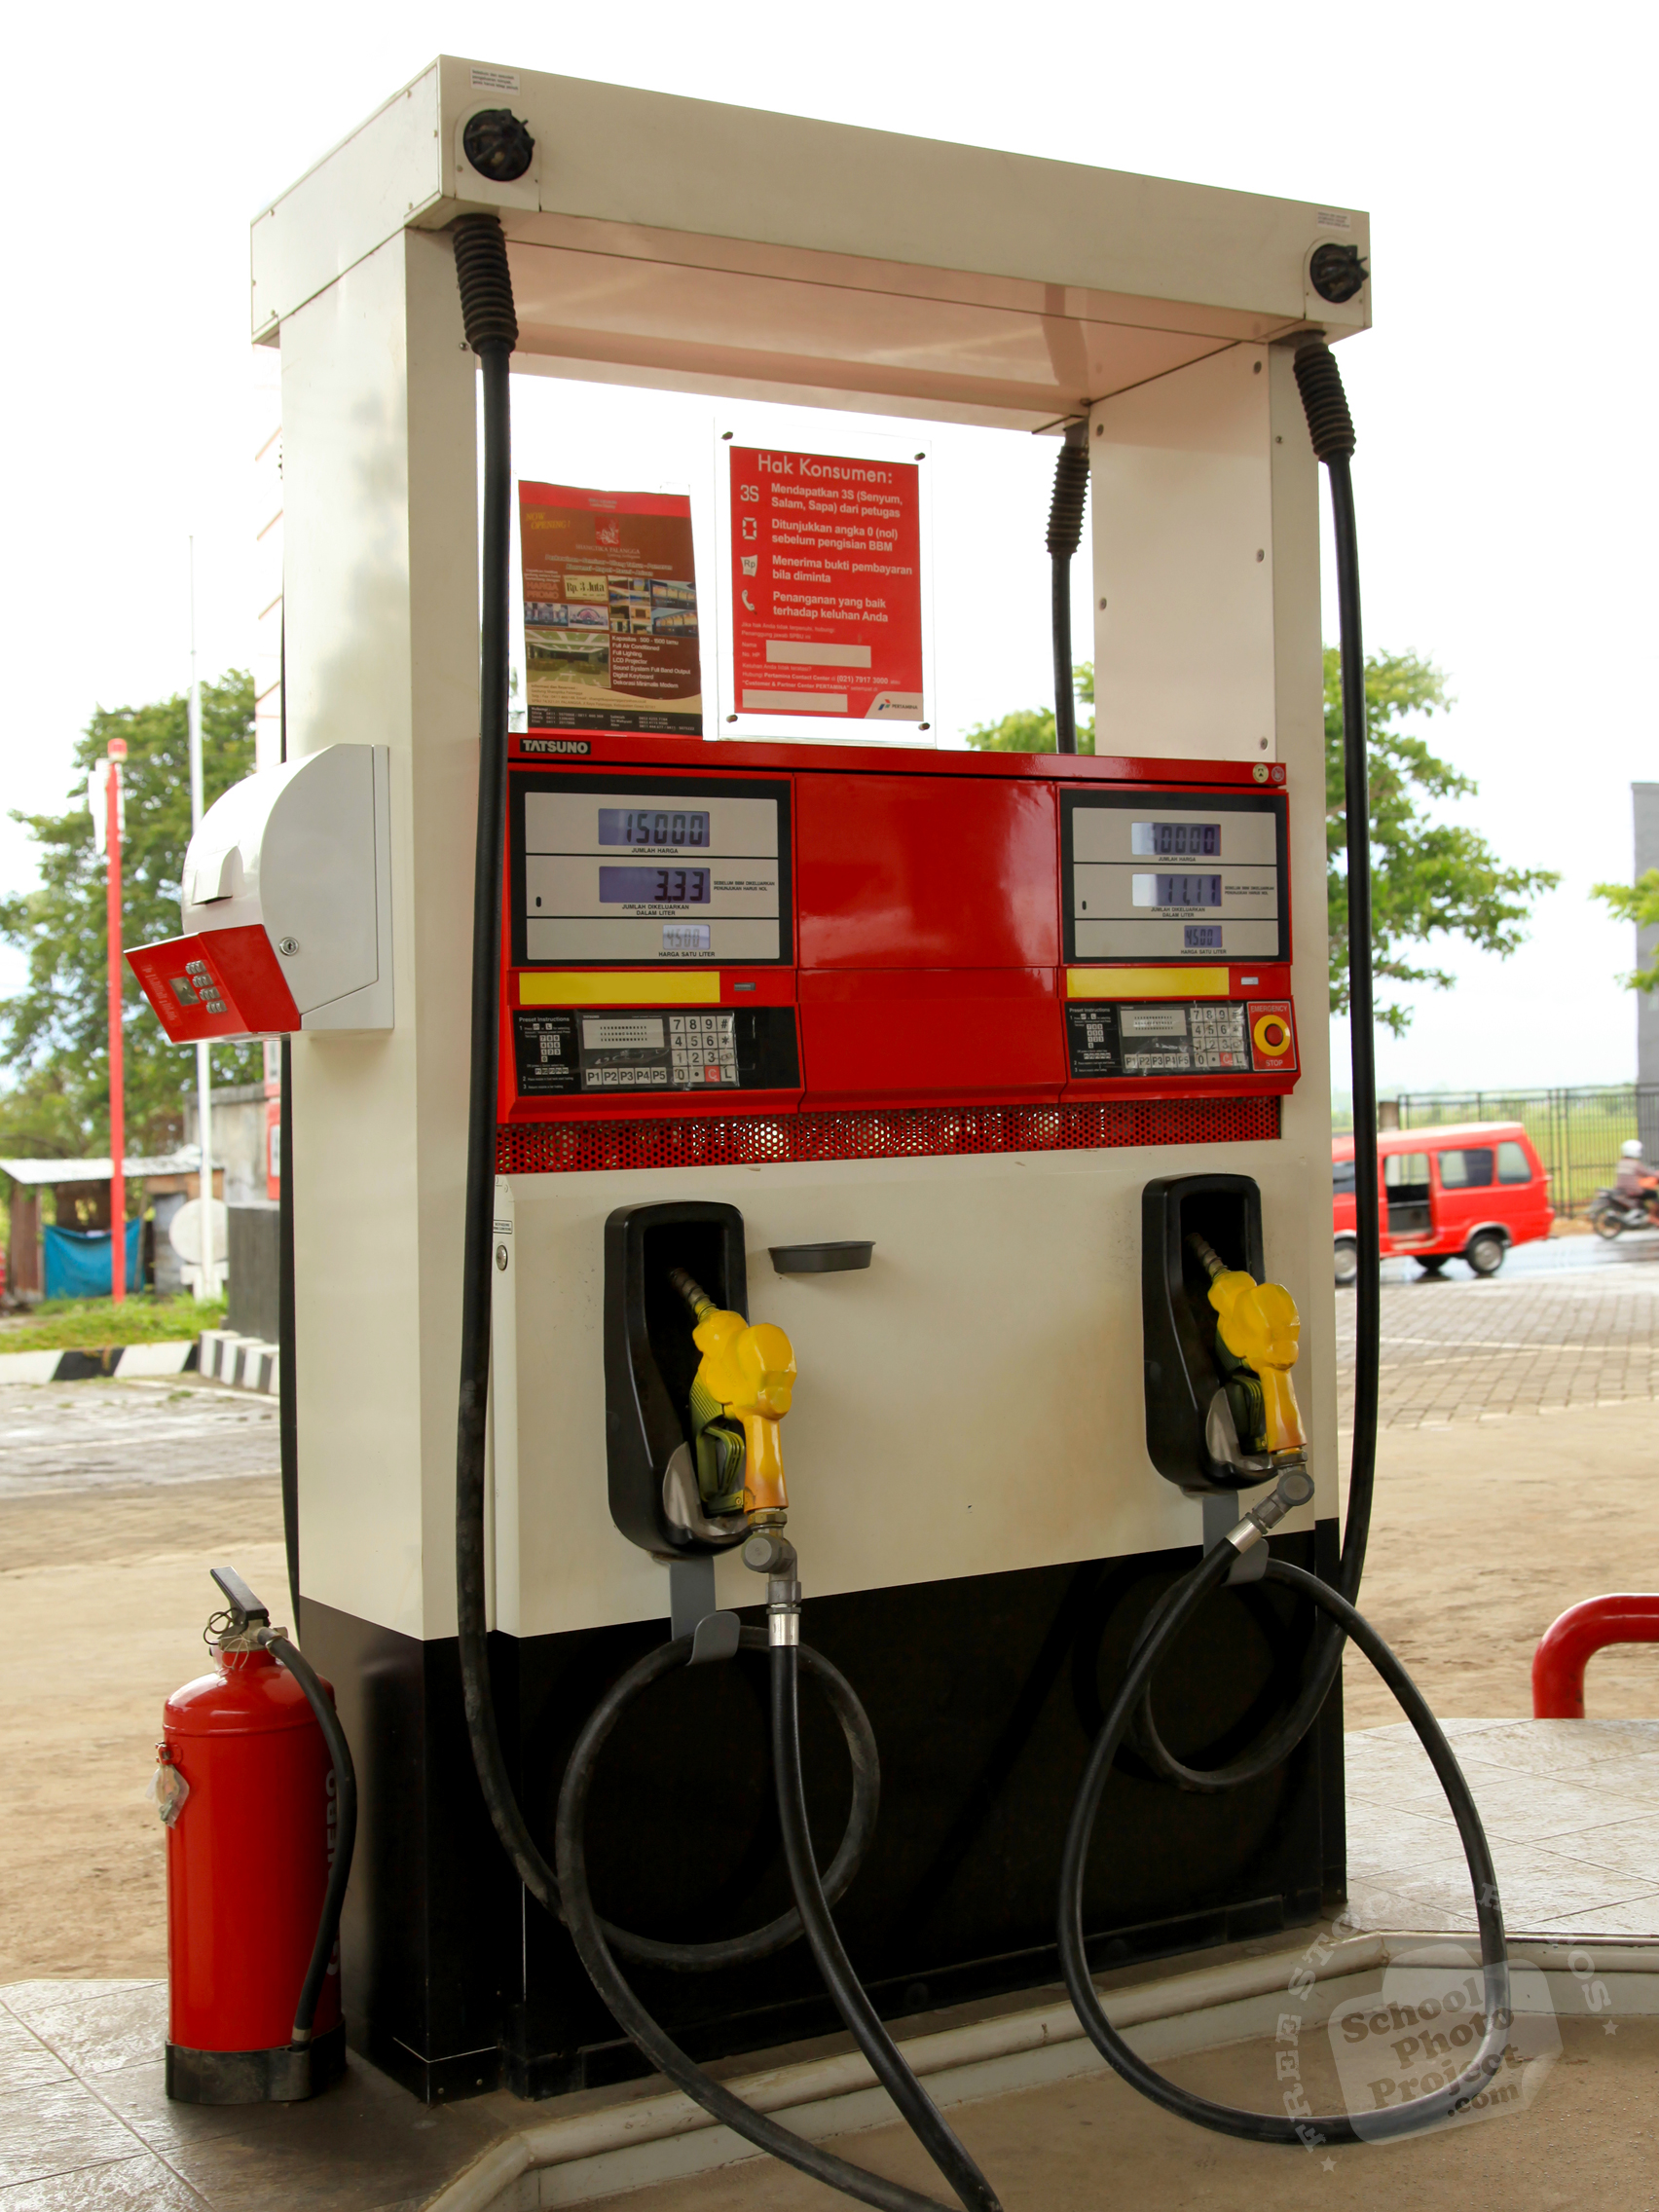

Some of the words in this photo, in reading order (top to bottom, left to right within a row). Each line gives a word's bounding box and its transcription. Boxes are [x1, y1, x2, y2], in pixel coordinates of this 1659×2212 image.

[758, 454, 793, 474] Hak
[799, 458, 893, 484] Konsumen:
[740, 485, 759, 502] 3S
[771, 483, 838, 498] Mendapatkan
[841, 488, 854, 498] 3S
[857, 490, 903, 505] (Senyum,
[772, 497, 805, 510] Salam,
[808, 500, 837, 514] Sapa)
[839, 502, 859, 514] dari
[862, 506, 901, 519] petugas
[526, 512, 545, 522] NOW
[772, 519, 831, 533] Ditunjukkan
[835, 526, 865, 537] angka
[867, 527, 873, 536] 0
[875, 528, 898, 540] (nol)
[772, 535, 815, 545] sebelum
[818, 537, 866, 550] pengisian
[868, 540, 893, 551] BBM
[744, 560, 756, 570] Rp
[772, 555, 822, 569] Menerima
[825, 559, 849, 571] bukti
[852, 562, 912, 575] pembayaran
[773, 570, 791, 580] bila
[793, 571, 830, 583] diminta
[527, 581, 559, 591] HARGA
[579, 582, 585, 591] 3
[587, 582, 605, 593] Juta
[527, 591, 559, 600] PROMO
[773, 591, 836, 606] Penanganan
[838, 596, 863, 608] yang
[866, 598, 886, 608] baik
[773, 606, 818, 619] terhadap
[821, 610, 860, 620] keluhan
[862, 612, 888, 622] Anda
[836, 675, 854, 683] (021)
[523, 740, 588, 754] TATSUNO
[627, 814, 703, 844] 15000
[654, 870, 704, 903] 3,33
[667, 928, 700, 948] 4500
[1186, 930, 1213, 945] 4500
[1194, 1011, 1199, 1019] 7
[1206, 1011, 1212, 1019] 8
[1219, 1010, 1225, 1019] 9
[673, 1019, 680, 1030] 7
[689, 1019, 696, 1029] 8
[705, 1019, 712, 1029] 9
[1196, 1025, 1201, 1034] 4
[1208, 1025, 1214, 1034] 5
[1220, 1025, 1227, 1034] 6
[675, 1037, 682, 1047] 4
[691, 1036, 697, 1046] 5
[707, 1036, 714, 1046] 6
[1209, 1040, 1215, 1049] 2
[1222, 1040, 1228, 1049] 3
[677, 1052, 682, 1063] 1
[692, 1053, 699, 1062] 2
[708, 1052, 715, 1062] 3
[1153, 1056, 1162, 1065] P3
[1198, 1055, 1203, 1064] 0
[1223, 1055, 1231, 1064] C
[588, 1073, 600, 1082] P1
[605, 1072, 616, 1081] P2
[620, 1072, 633, 1081] P3
[637, 1071, 649, 1080] P4
[653, 1071, 666, 1080] P5
[708, 1069, 717, 1080] C
[724, 1069, 731, 1079] L
